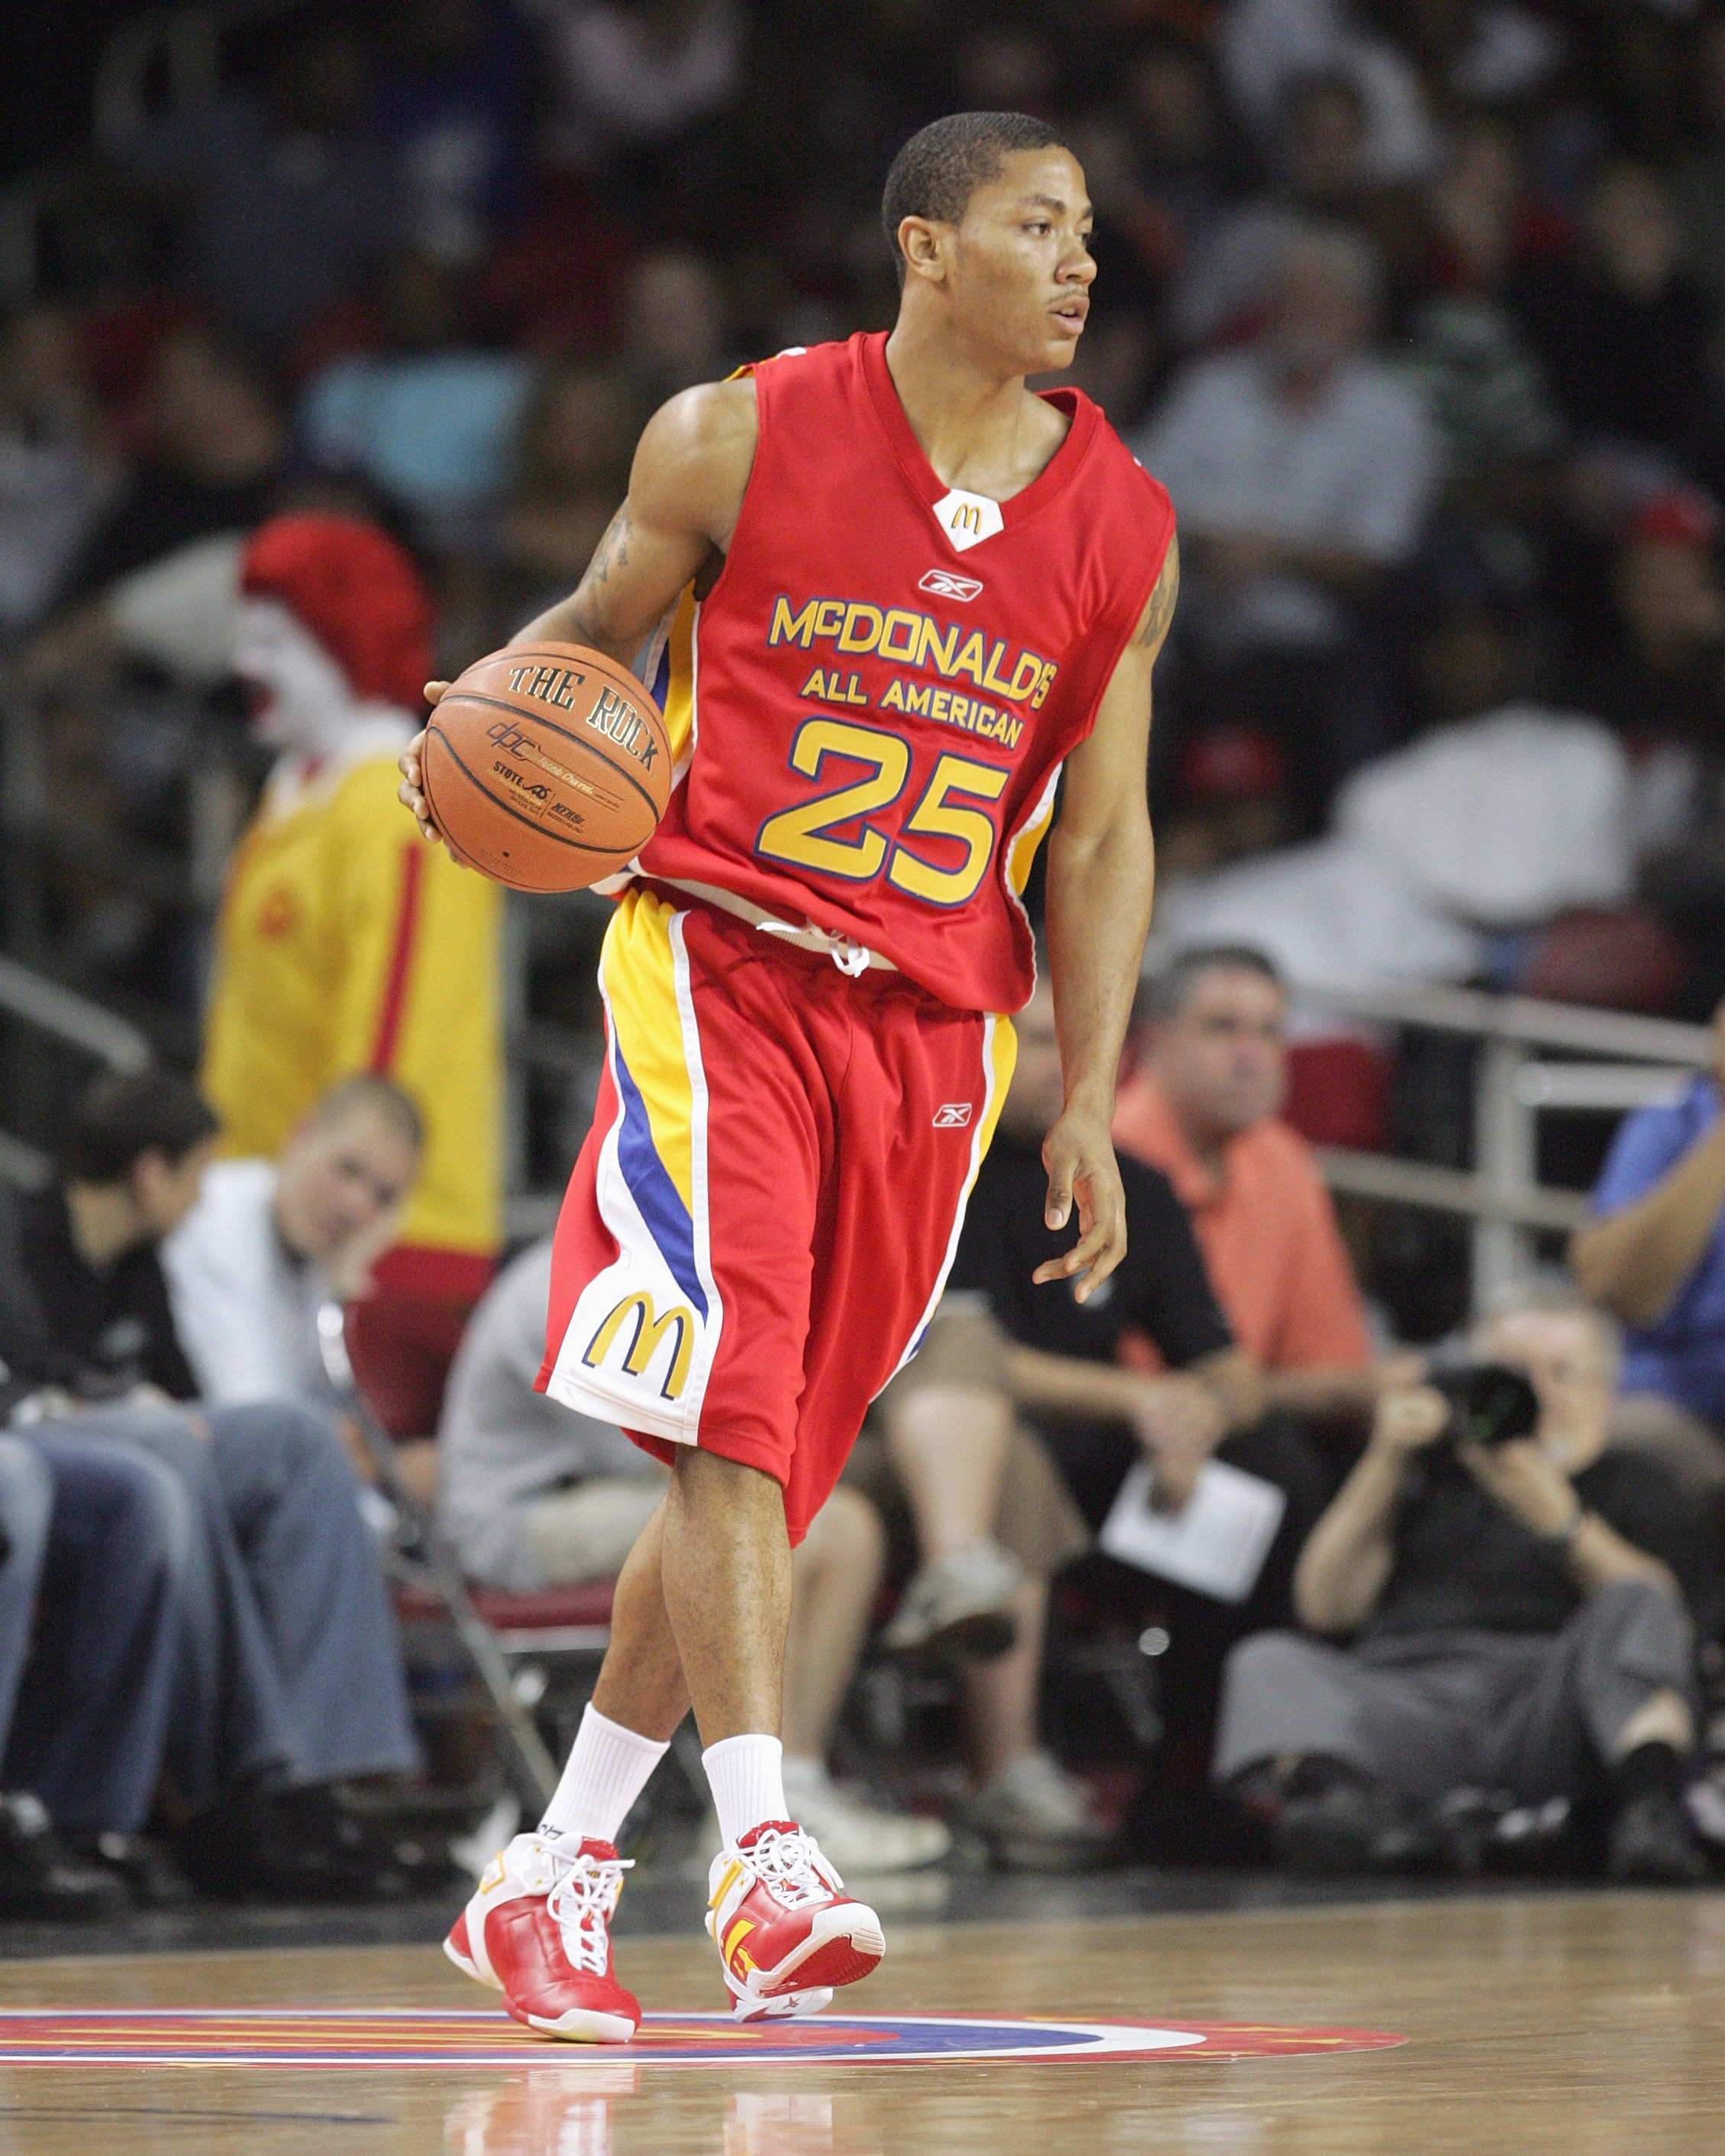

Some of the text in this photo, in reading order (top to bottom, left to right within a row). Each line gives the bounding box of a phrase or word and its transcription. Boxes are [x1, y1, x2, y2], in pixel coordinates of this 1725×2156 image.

[508, 665, 659, 771] THE ROCK
[800, 667, 1025, 751] ALL AMERICAN
[753, 715, 1012, 909] 25
